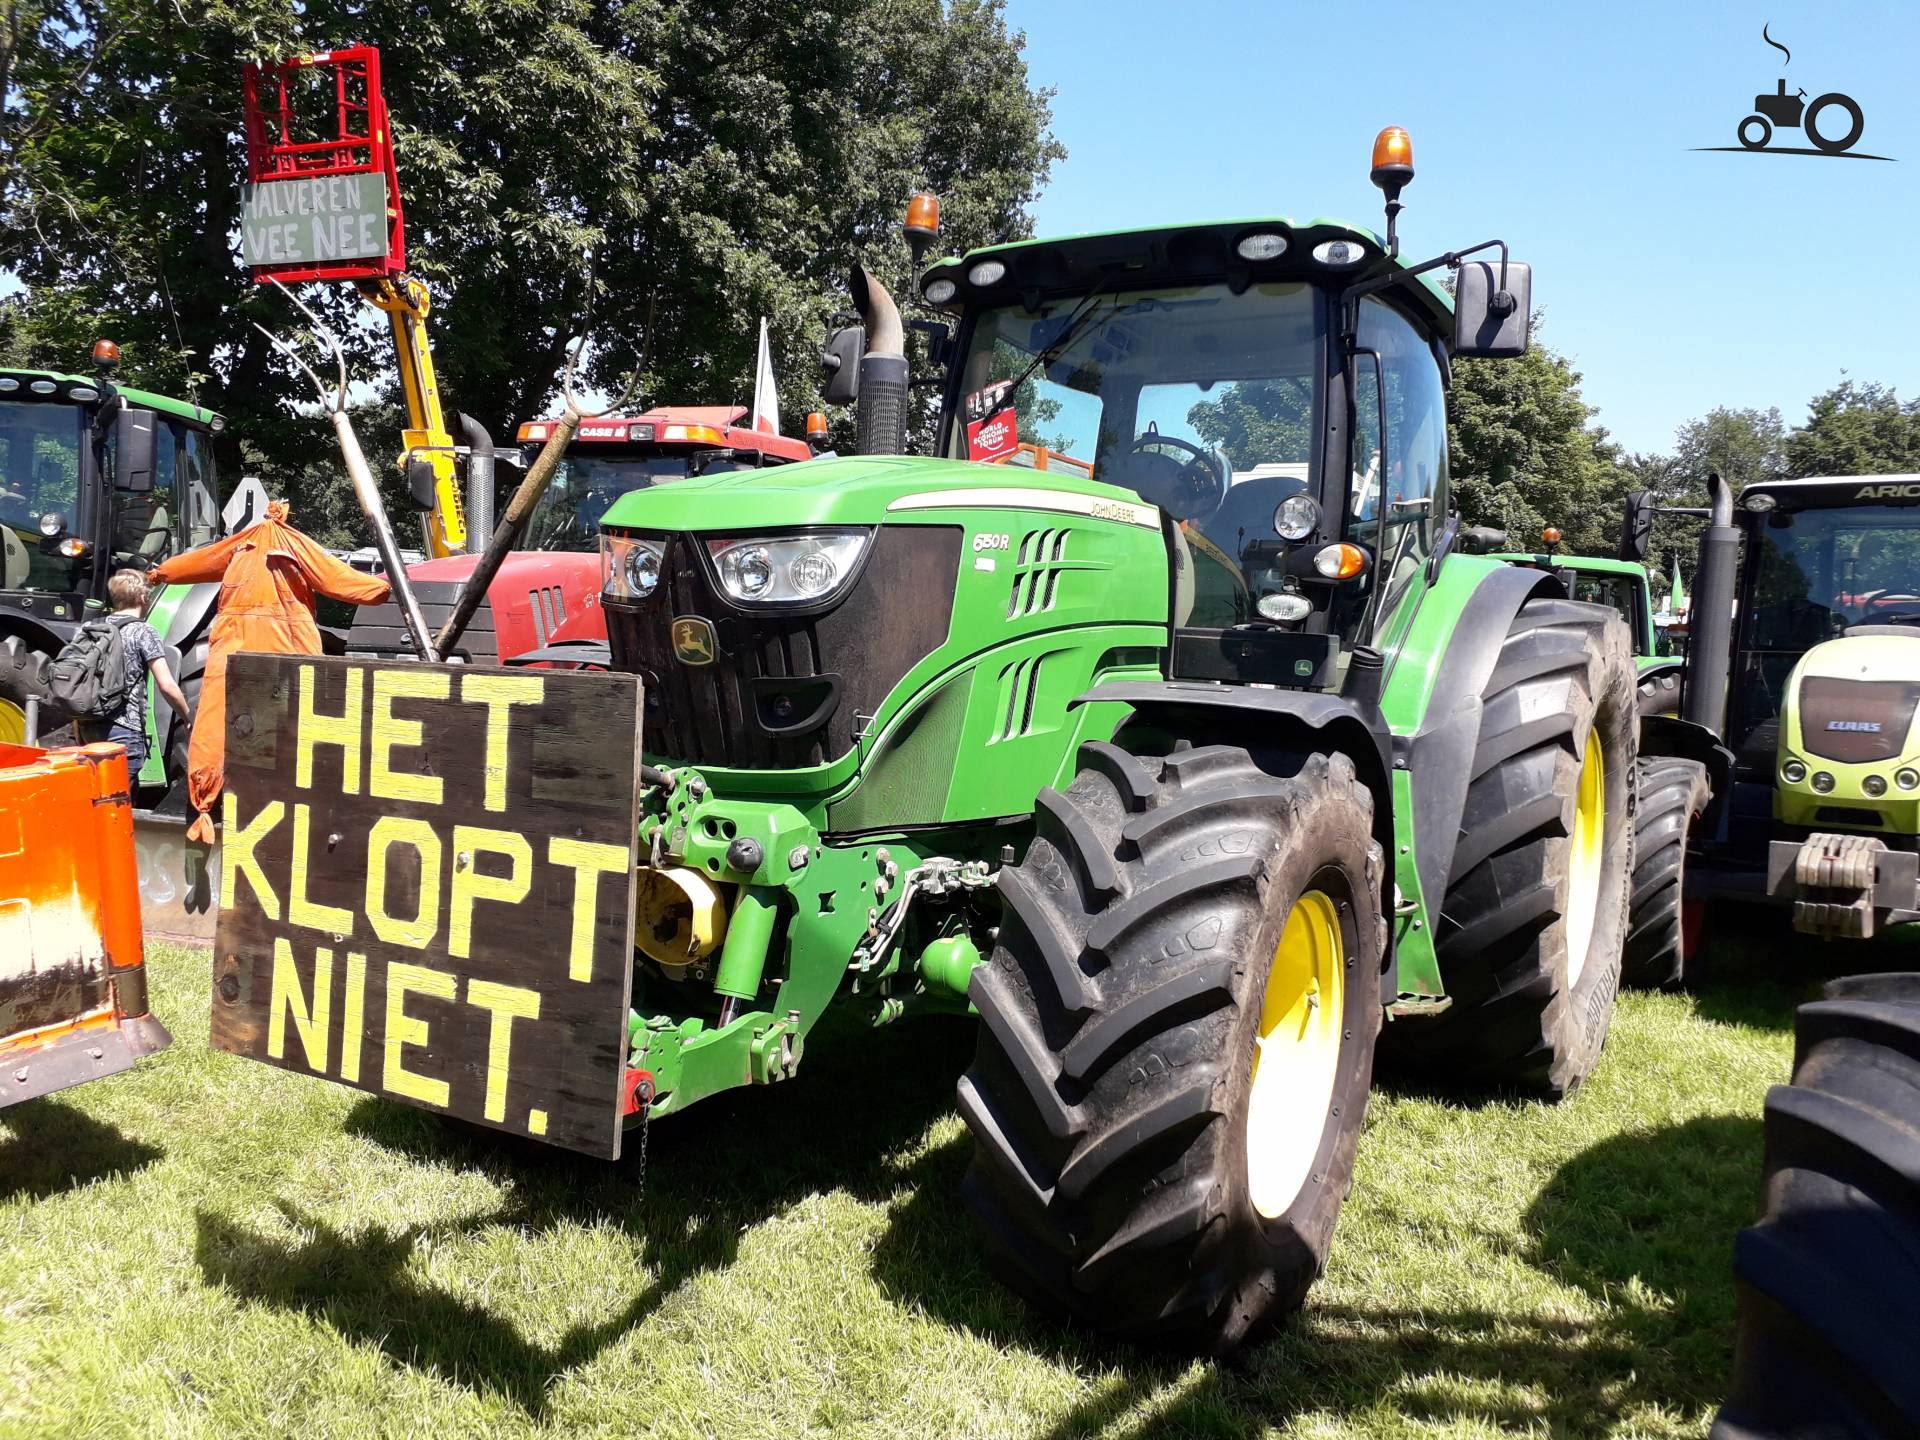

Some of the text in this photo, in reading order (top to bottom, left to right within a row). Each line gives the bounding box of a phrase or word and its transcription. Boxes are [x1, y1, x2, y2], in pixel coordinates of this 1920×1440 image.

[241, 178, 361, 220] HALVEREN
[246, 213, 380, 260] VEE NEE
[580, 427, 614, 437] CASE
[973, 425, 1009, 445] ECONOMIC
[979, 422, 1003, 436] WORLD
[979, 434, 1004, 449] FORUM
[296, 665, 545, 812] HET
[1824, 720, 1881, 732] CLAAS
[218, 792, 630, 983] KLOPT
[267, 937, 548, 1136] NIET.
